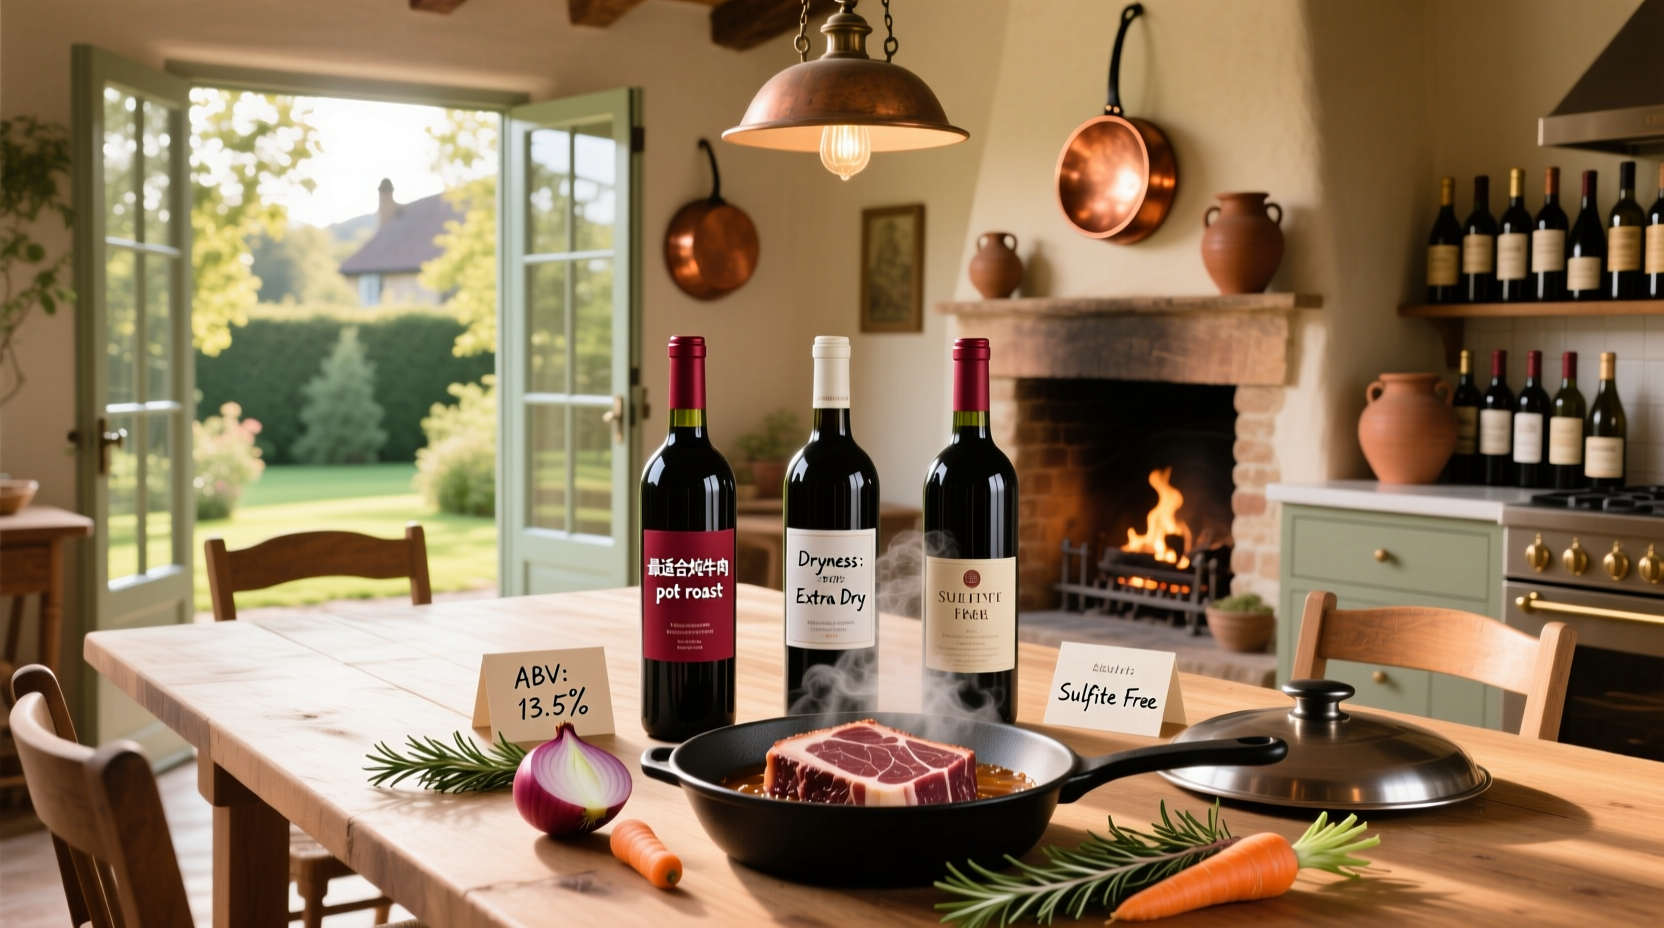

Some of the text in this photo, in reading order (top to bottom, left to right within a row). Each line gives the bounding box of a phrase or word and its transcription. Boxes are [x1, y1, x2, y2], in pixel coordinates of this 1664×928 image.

[798, 550, 863, 576] Dryness:
[656, 582, 724, 605] pot roast
[796, 587, 867, 612] Extra Dry
[514, 663, 568, 690] ABV:
[518, 686, 589, 721] 13.5%
[1058, 682, 1158, 712] Sulfite Free
